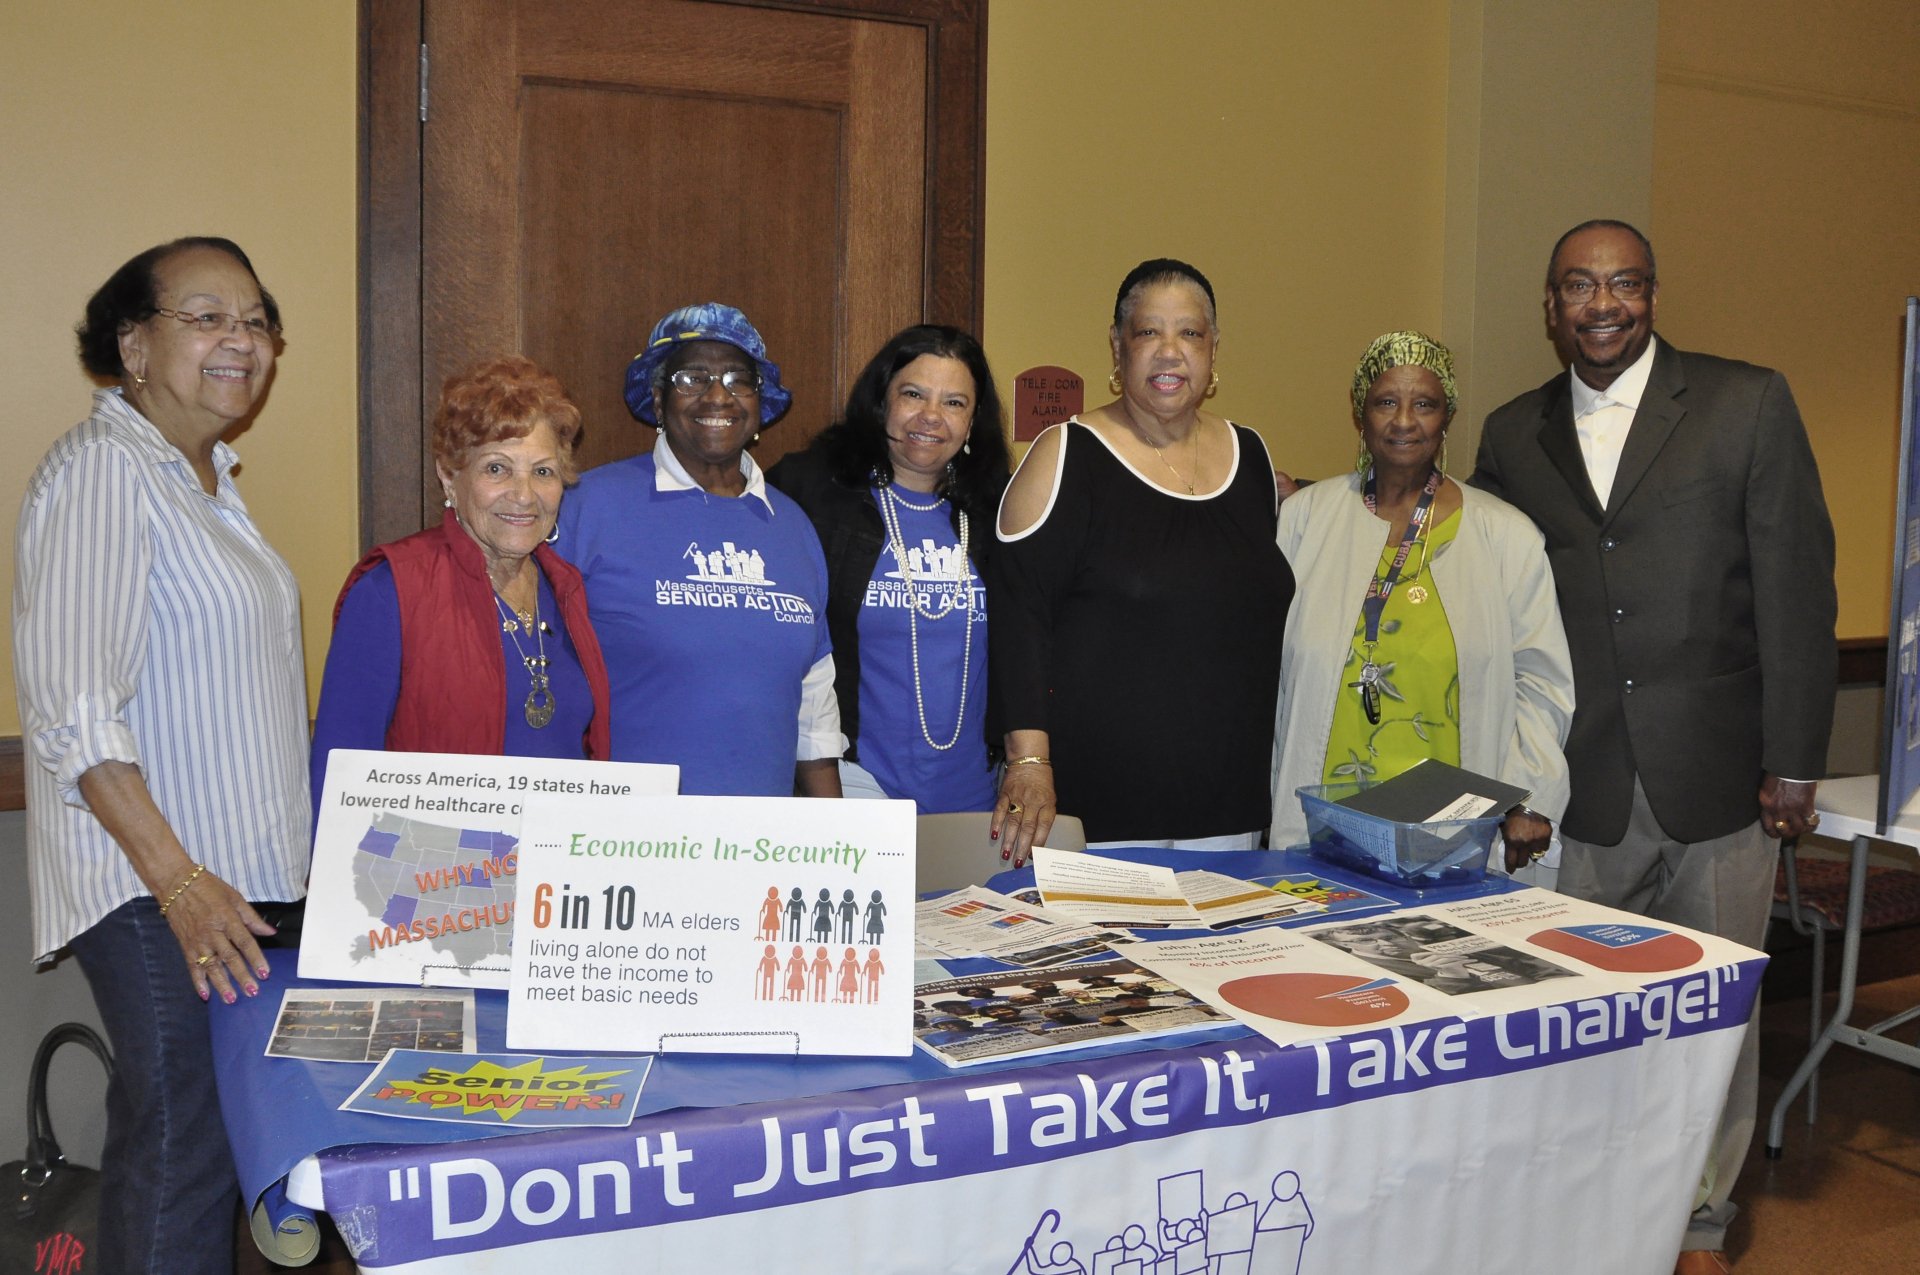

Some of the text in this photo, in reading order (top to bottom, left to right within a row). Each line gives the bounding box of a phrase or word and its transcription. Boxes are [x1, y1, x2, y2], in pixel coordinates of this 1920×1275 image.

[1021, 378, 1078, 390] TELE COM
[1038, 392, 1061, 403] FIRE
[1032, 405, 1067, 416] ALARM
[1393, 540, 1413, 568] CUBA
[655, 579, 764, 596] Massachusetts
[862, 587, 987, 609] ENIOR ACTI
[655, 591, 813, 614] SENIOR ACTION
[774, 610, 815, 625] Council
[366, 768, 632, 796] Across America, 19 states have
[340, 791, 410, 811] lowered
[415, 796, 506, 815] healthcare
[568, 833, 867, 874] Economic In-Security
[415, 853, 518, 894] WHY NO
[532, 882, 740, 931] 6 in 10 MA elders
[368, 900, 517, 951] MASSACHU
[530, 939, 706, 962] living alone do not
[1157, 938, 1248, 952] John, Age 62
[1231, 954, 1286, 966] Income
[528, 961, 714, 984] have the income to
[930, 980, 957, 989] fight
[970, 974, 1005, 985] bridge
[1005, 971, 1025, 980] the
[1025, 970, 1045, 978] gap
[1058, 962, 1111, 973] affordable
[526, 984, 698, 1005] meet basic needs
[924, 985, 941, 994] for
[412, 1071, 610, 1092] Senior
[371, 1087, 627, 1111] POWER!
[388, 963, 1740, 1242] "Don't Just Take It, Take Charge!"
